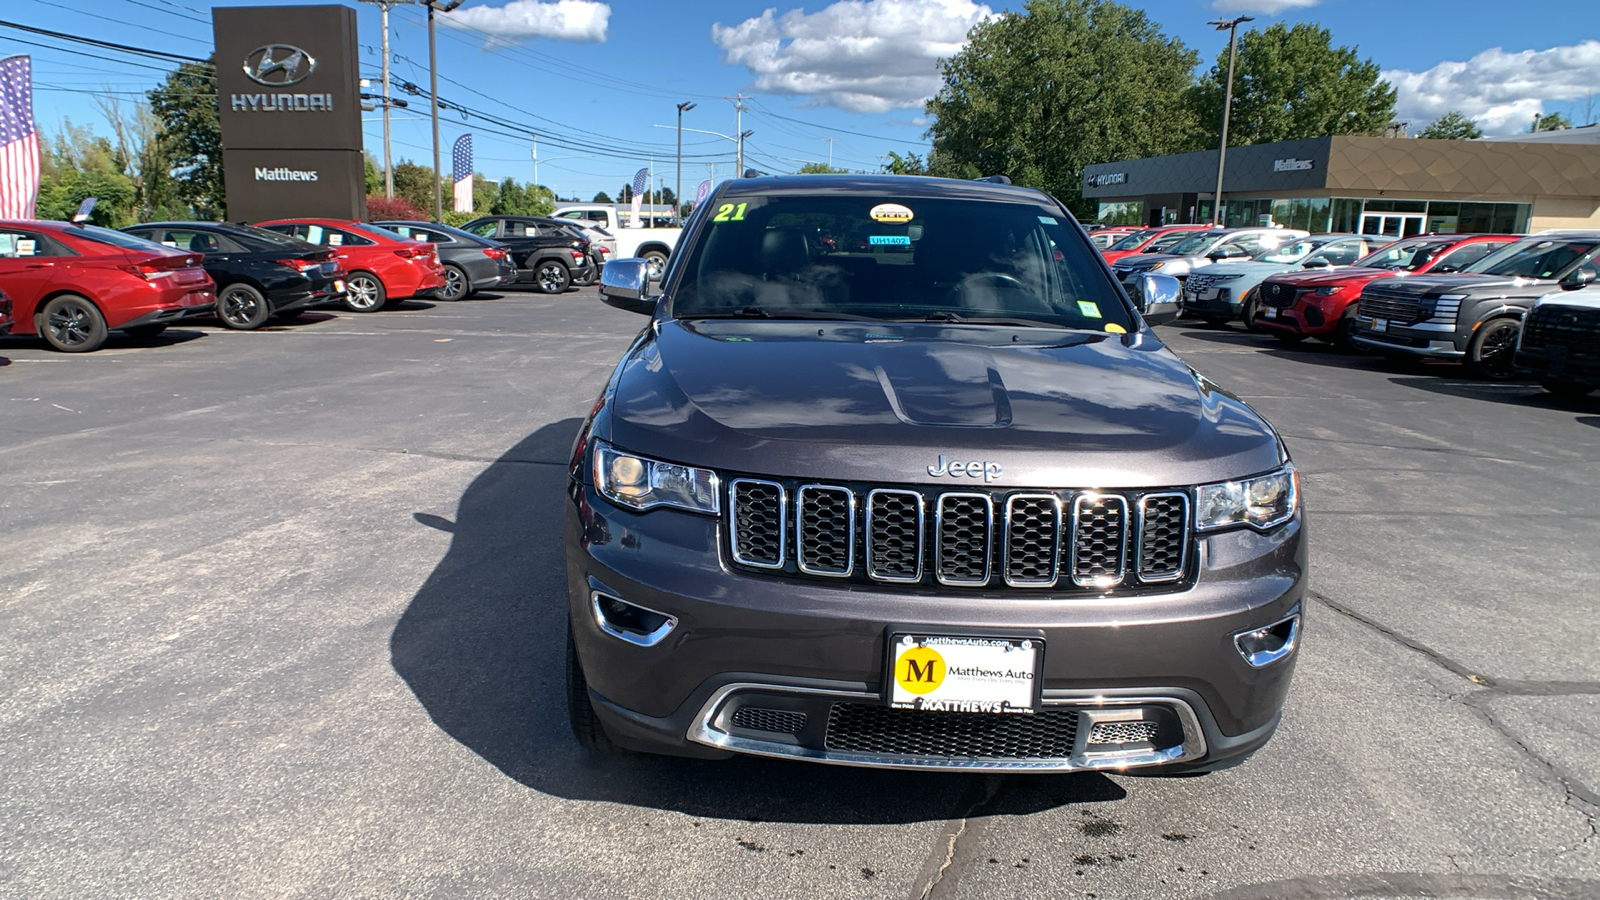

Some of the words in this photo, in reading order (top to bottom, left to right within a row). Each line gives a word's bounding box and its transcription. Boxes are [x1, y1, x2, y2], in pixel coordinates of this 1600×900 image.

[231, 93, 333, 112] HYUNDAI
[1273, 158, 1313, 172] Matthews
[254, 167, 318, 182] Matthews
[1097, 173, 1127, 186] HYUNDAI
[713, 202, 747, 222] 21
[926, 453, 1003, 483] Jeep
[925, 636, 1010, 648] MatthewsAuto.com
[902, 658, 938, 684] M
[948, 666, 1004, 678] Matthews
[1004, 669, 1034, 680] Auto
[920, 699, 1002, 714] MATTHEWS
